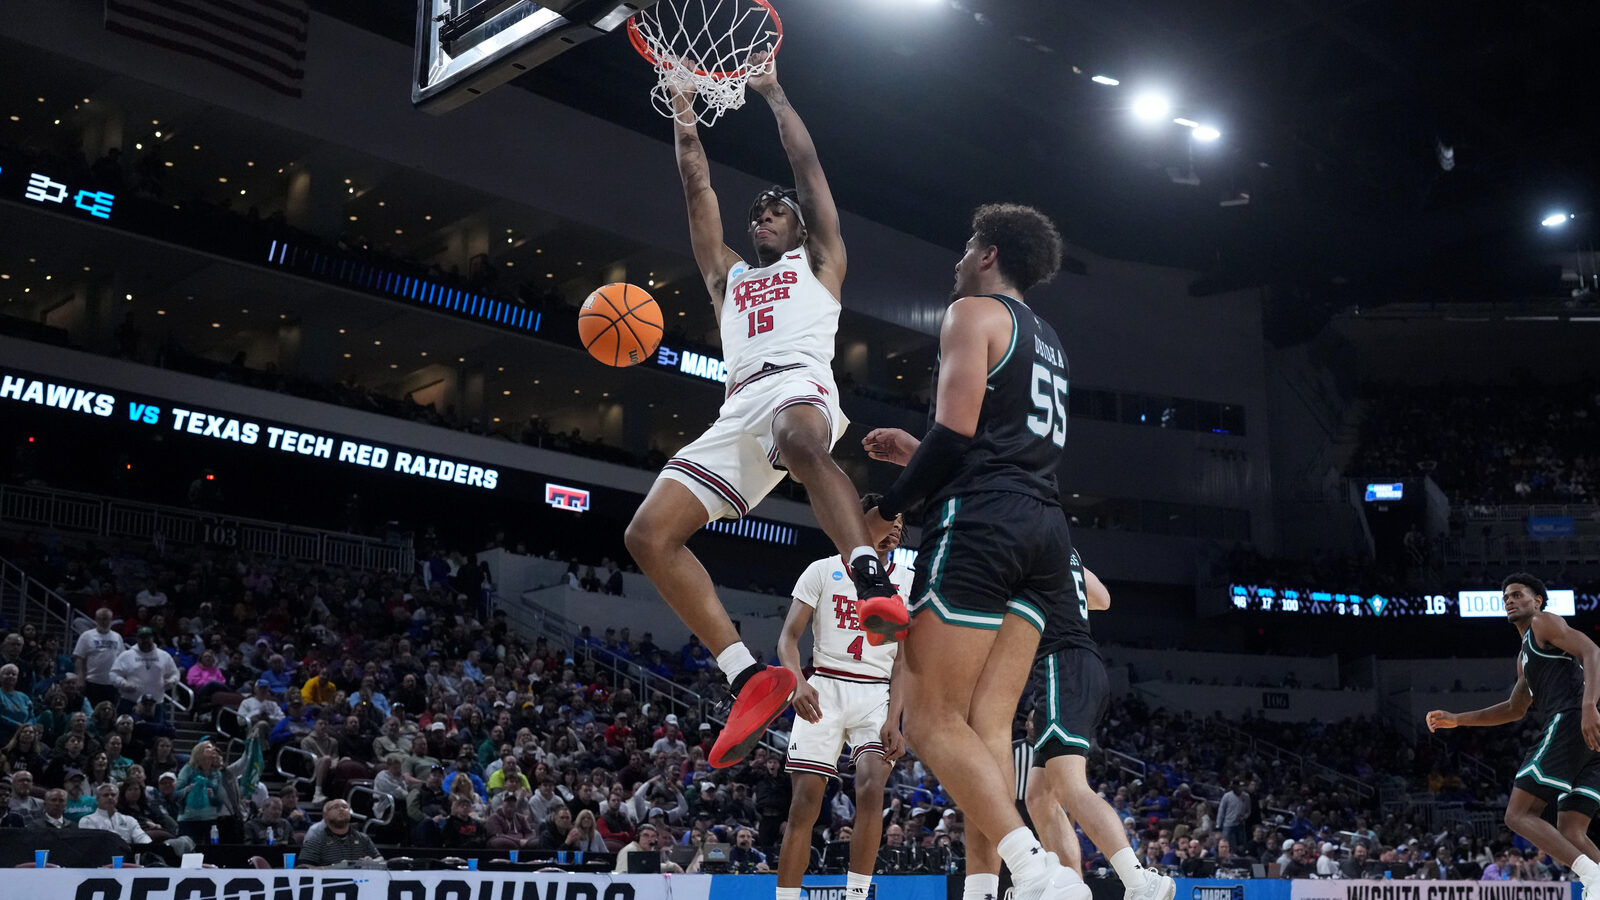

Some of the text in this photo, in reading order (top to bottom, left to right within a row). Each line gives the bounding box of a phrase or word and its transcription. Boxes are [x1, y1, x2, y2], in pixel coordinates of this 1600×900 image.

[732, 271, 798, 300] TEXAS
[734, 286, 790, 313] TECH
[748, 306, 774, 338] 15
[680, 350, 727, 383] MARC
[1026, 361, 1070, 449] 55
[0, 375, 499, 490] HAWKS VS TEXAS TECH RED RAIDERS
[1070, 569, 1088, 621] 5
[1423, 595, 1447, 615] 16
[1465, 595, 1504, 613] 10:0
[847, 635, 864, 661] 4
[809, 888, 847, 900] MARC
